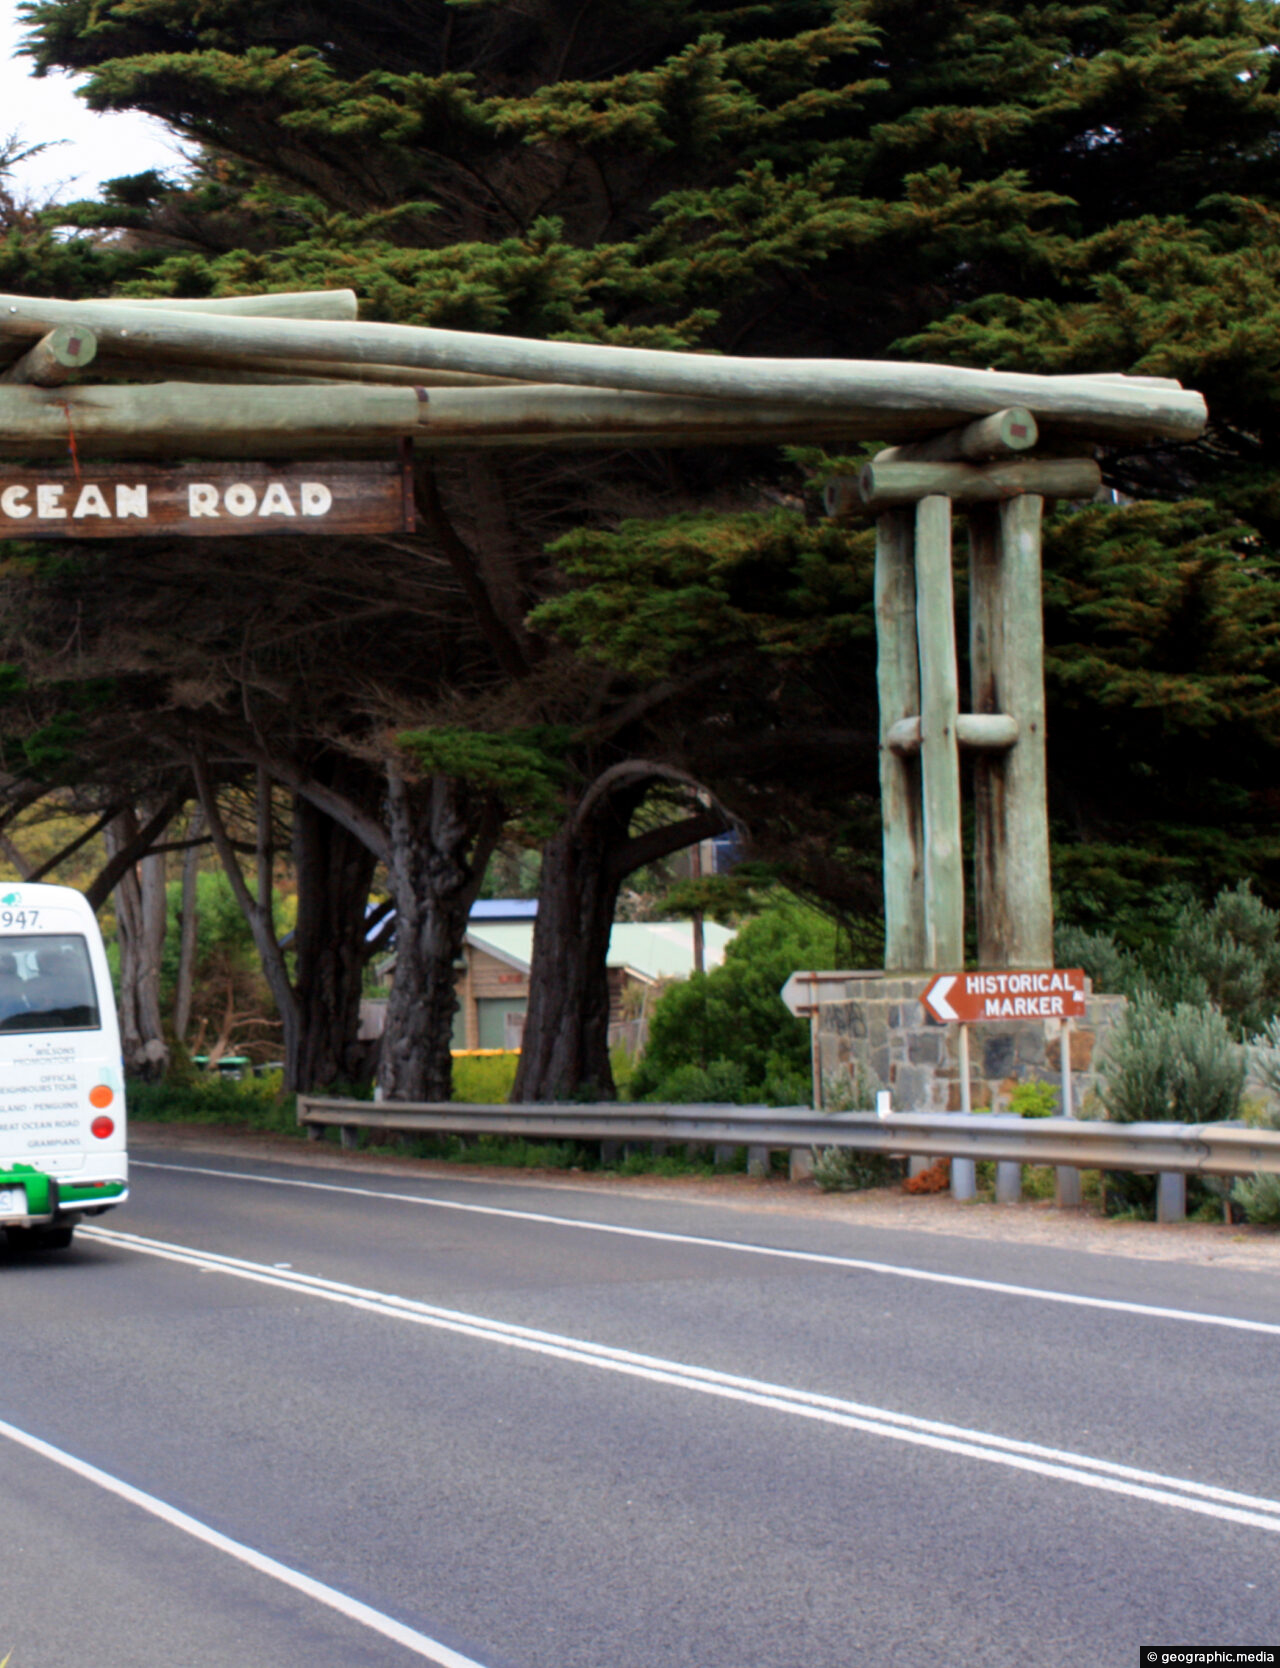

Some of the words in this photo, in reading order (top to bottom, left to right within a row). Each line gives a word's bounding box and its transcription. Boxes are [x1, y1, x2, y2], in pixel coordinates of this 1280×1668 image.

[188, 482, 333, 518] ROAD
[966, 973, 1076, 995] HISTORICAL
[985, 996, 1064, 1016] MARKER
[36, 1047, 76, 1056] WILSONS
[54, 1083, 78, 1091] TOUR
[33, 1102, 79, 1111] PENGUINS
[21, 1121, 53, 1130] OCEAN
[55, 1119, 80, 1128] ROAD
[27, 1138, 81, 1148] GRAMPIANS
